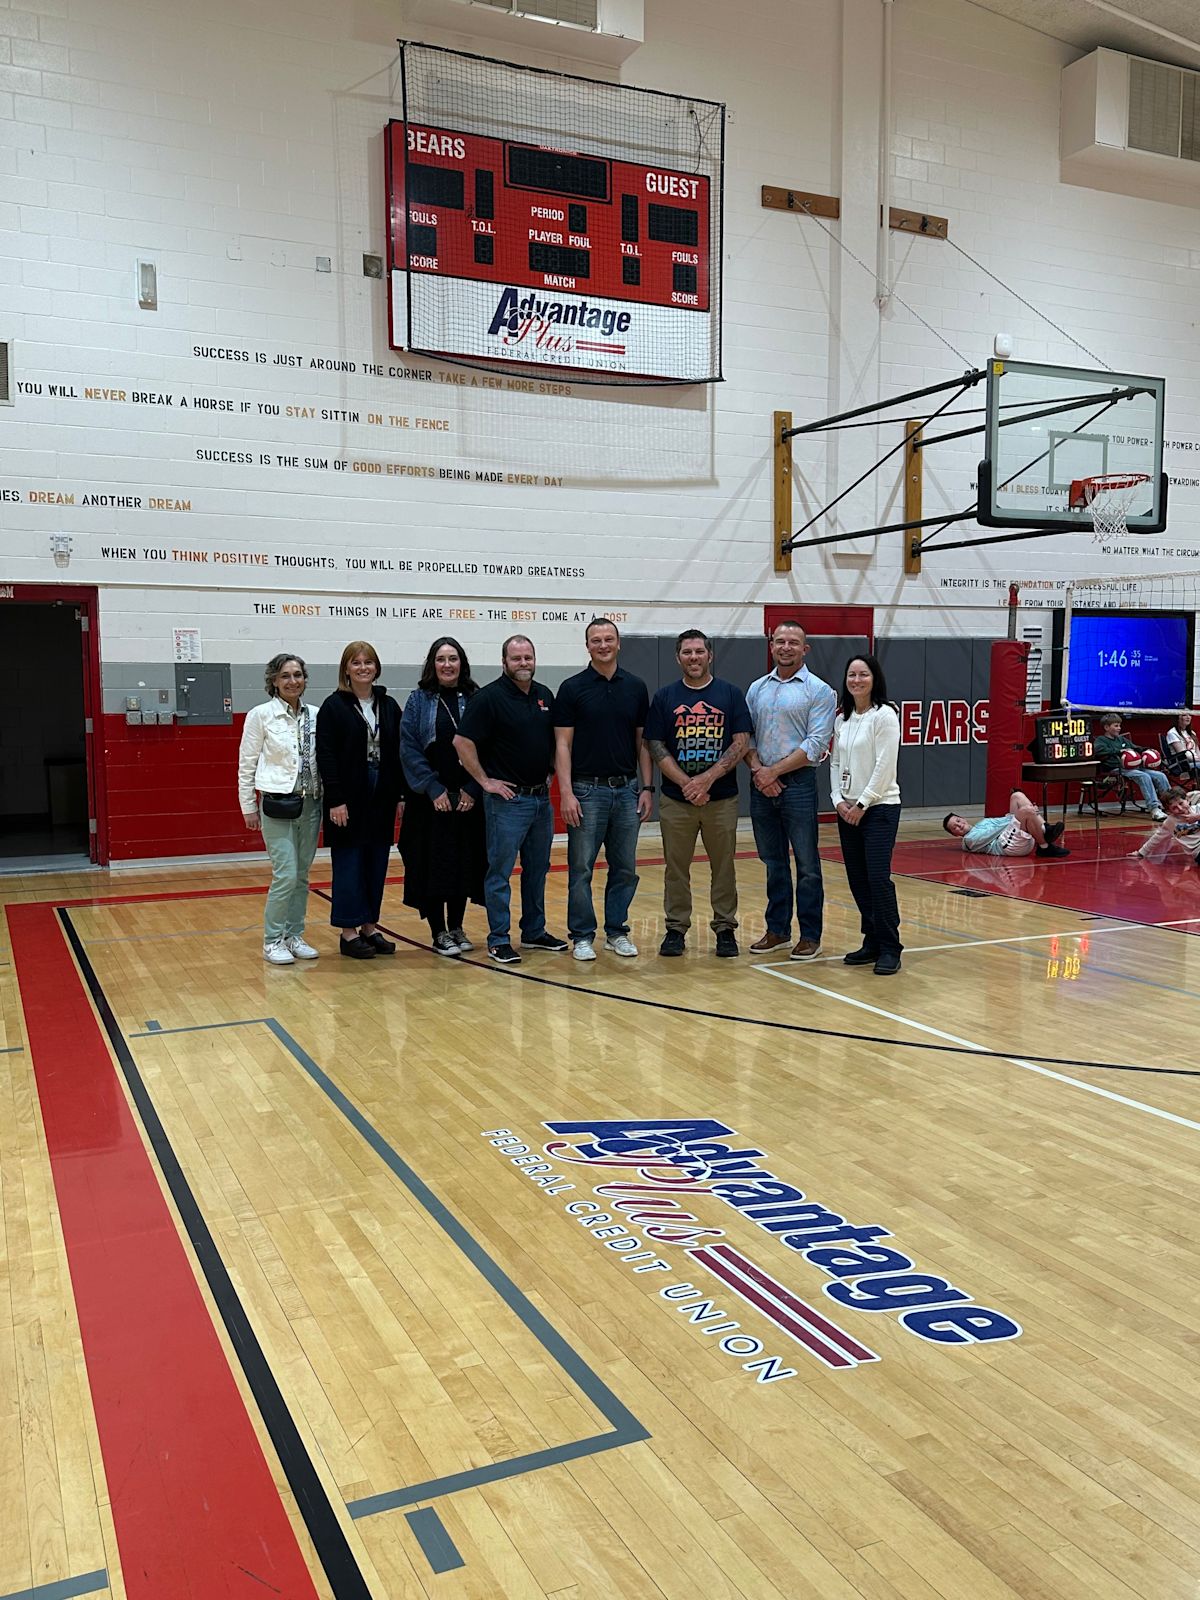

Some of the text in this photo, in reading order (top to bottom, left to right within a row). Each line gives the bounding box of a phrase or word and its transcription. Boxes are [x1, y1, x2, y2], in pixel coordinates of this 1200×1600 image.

[408, 129, 466, 159] BEARS
[646, 172, 699, 199] GUEST
[531, 206, 564, 221] PERIOD
[471, 220, 496, 234] T.O.L.
[529, 229, 592, 249] PLAYER FOUL
[620, 243, 642, 256] T.O.L.
[672, 251, 698, 264] FOULS
[544, 274, 575, 288] MATCH
[671, 292, 698, 305] SCORE
[488, 287, 632, 337] Advantage
[503, 312, 574, 352] Plus
[487, 346, 627, 371] FEDERAL CREDIT UNION
[193, 346, 249, 362] SUCCESS
[255, 352, 267, 363] IS
[273, 354, 303, 367] JUST
[310, 358, 356, 373] AROUND
[362, 363, 384, 376] THE
[438, 371, 466, 385] TAKE
[471, 375, 478, 386] A
[482, 377, 502, 389] FEW
[507, 379, 534, 392] MORE
[539, 384, 571, 395] STEPS
[17, 381, 449, 431] YOU WILL NEVER BREAK A HORSE IF YOU STAY SITTIN ON THE FENCE
[1127, 437, 1148, 446] POWER
[1172, 441, 1193, 450] POWER
[196, 449, 563, 487] SUCCESS IS THE SUM OF GOOD EFFORTS BEING MADE EVERY DAY
[1016, 485, 1039, 494] BLESS
[1169, 477, 1200, 487] EWARDING
[29, 491, 75, 505] DREAM
[82, 494, 142, 508] ANOTHER
[148, 498, 192, 511] DREAM
[1102, 546, 1111, 554] NO
[1113, 546, 1139, 555] MATTER
[1142, 547, 1159, 556] WHAT
[1162, 548, 1174, 556] THE
[101, 547, 137, 560] WHEN
[142, 548, 167, 561] YOU
[171, 549, 208, 563] THINK
[213, 551, 269, 566] POSITIVE
[345, 558, 366, 569] YOU
[370, 560, 394, 570] WILL
[399, 560, 412, 571] BE
[417, 561, 478, 574] PROPELLED
[483, 564, 523, 575] TOWARD
[528, 566, 585, 577] GREATNESS
[940, 578, 978, 588] INTEGRITY
[982, 579, 990, 588] IS
[993, 579, 1006, 588] THE
[1056, 581, 1065, 589] OF
[1122, 583, 1137, 592] LIFE
[1025, 599, 1043, 607] FROM
[253, 603, 276, 614] THE
[281, 604, 321, 616] WORST
[328, 606, 369, 617] THINGS
[376, 607, 387, 617] IN
[392, 608, 417, 618] LIFE
[422, 608, 443, 618] ARE
[449, 609, 475, 619] FREE
[488, 609, 507, 620] THE
[511, 610, 537, 621] BEST
[542, 611, 568, 621] COME
[573, 612, 587, 622] AT
[602, 613, 628, 622] COST
[1098, 650, 1128, 668] 1:46
[1130, 659, 1141, 668] PM
[675, 714, 725, 727] APFCU
[895, 700, 990, 746] EARS
[1051, 719, 1085, 736] 14:00
[675, 726, 724, 739] APFCU
[677, 738, 723, 750] APFCU
[678, 750, 722, 762] APFCU
[543, 1134, 726, 1247] Plus
[541, 1118, 1023, 1346] Advantage
[481, 1128, 799, 1384] FEDERAL CREDIT UNION
